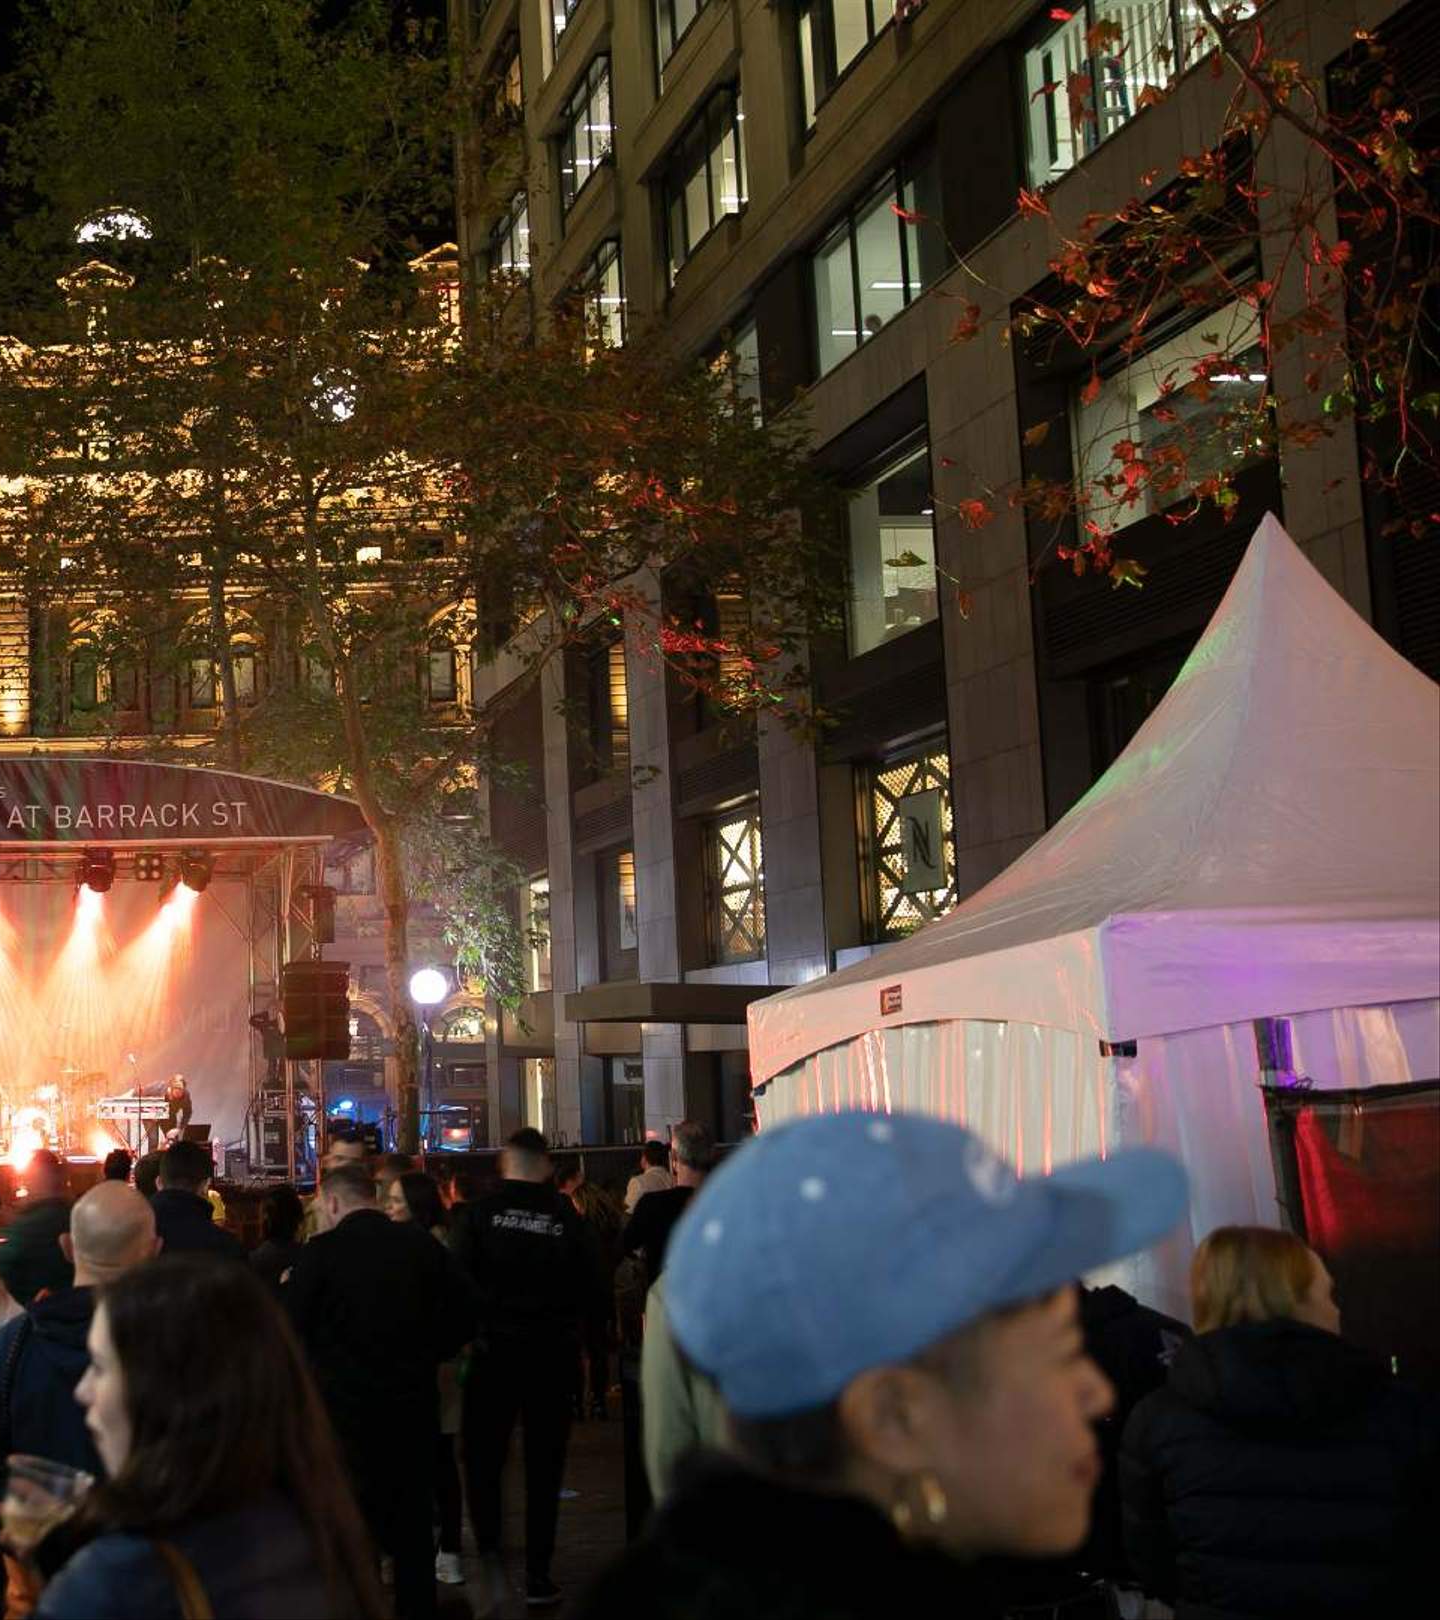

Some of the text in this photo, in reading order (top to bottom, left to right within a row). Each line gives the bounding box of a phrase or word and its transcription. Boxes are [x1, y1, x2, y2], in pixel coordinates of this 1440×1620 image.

[7, 804, 41, 829] AT
[54, 802, 200, 829] BARRACK
[212, 801, 248, 827] ST
